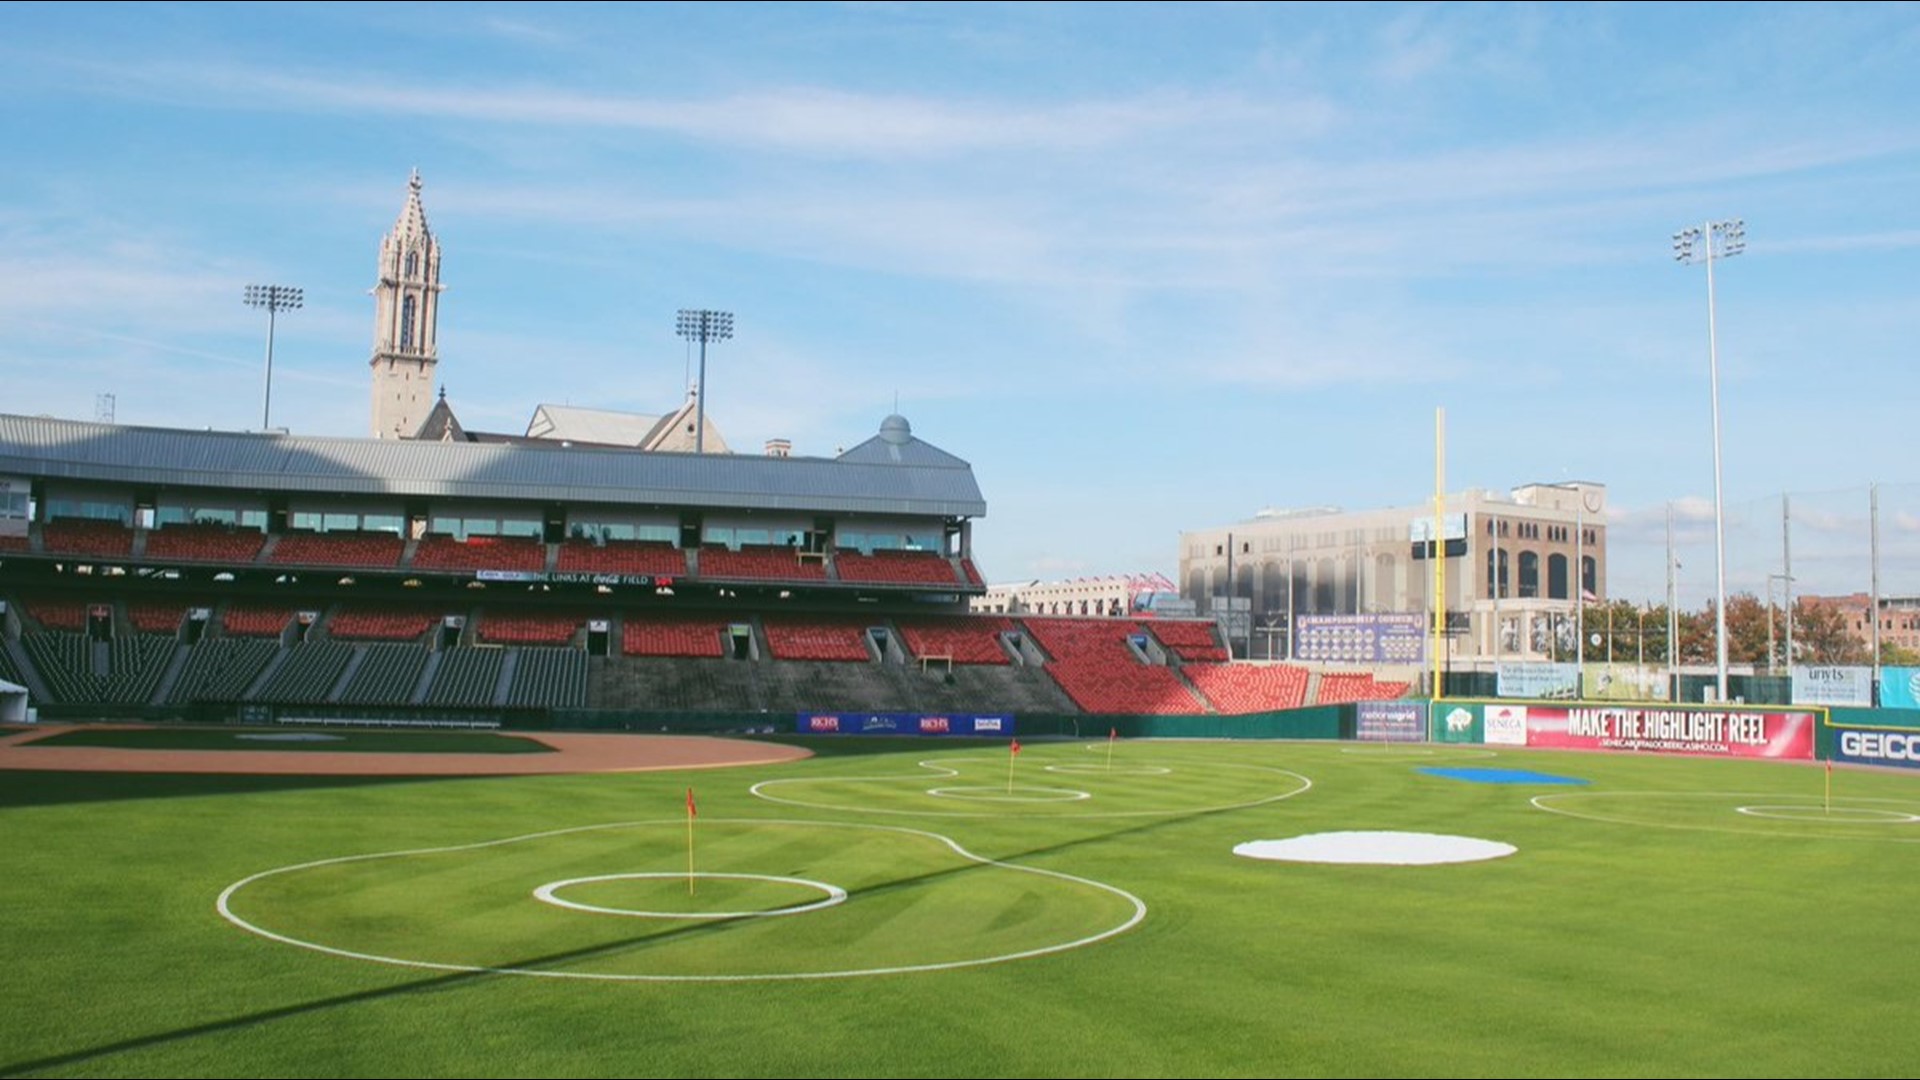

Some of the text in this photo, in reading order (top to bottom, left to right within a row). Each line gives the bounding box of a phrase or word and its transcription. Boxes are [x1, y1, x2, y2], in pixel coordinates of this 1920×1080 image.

[552, 573, 577, 582] LINKS
[579, 574, 590, 582] AT
[623, 575, 648, 584] FIELD
[1487, 719, 1522, 730] SENECA
[1568, 709, 1768, 745] MAKE THE HIGHLIGHT REEL
[1841, 731, 1920, 761] GEICO
